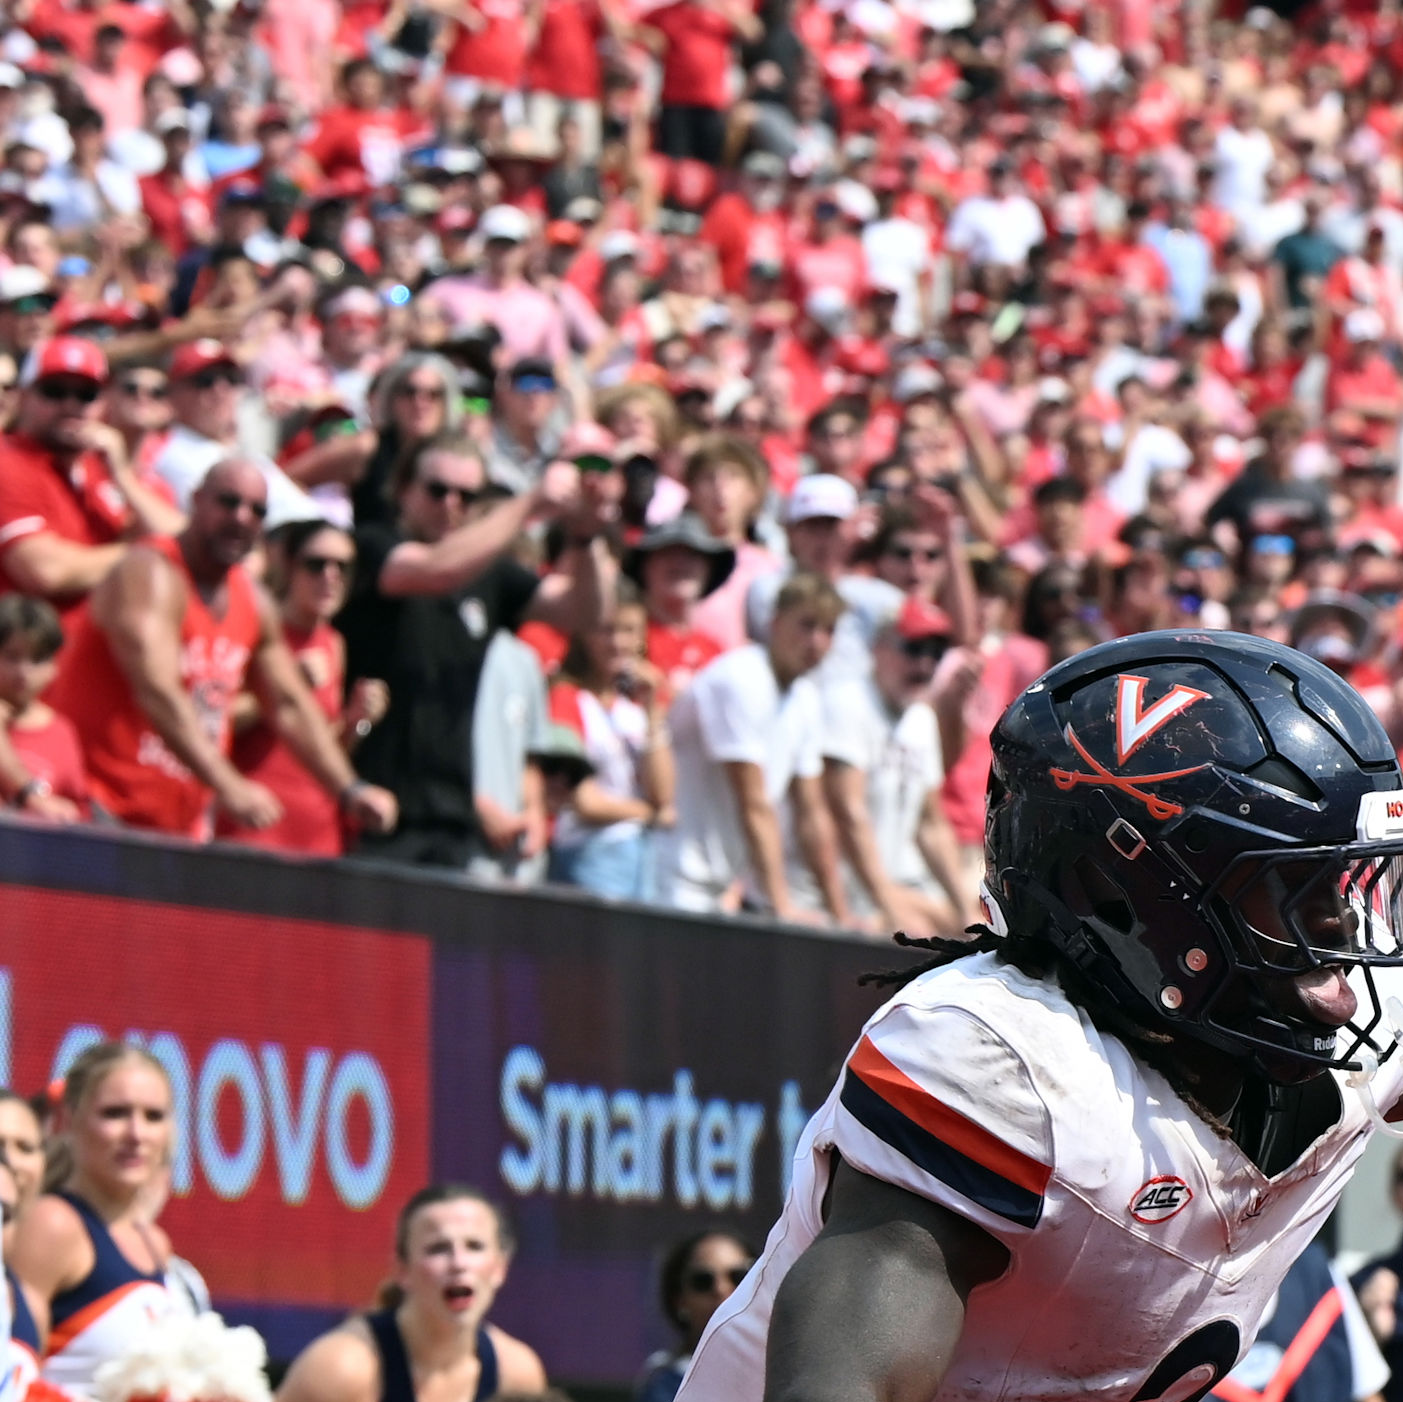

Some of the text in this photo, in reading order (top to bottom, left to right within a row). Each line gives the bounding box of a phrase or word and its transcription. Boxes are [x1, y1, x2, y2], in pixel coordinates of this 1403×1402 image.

[1115, 673, 1213, 767] V
[499, 1043, 766, 1213] Smarter
[1135, 1185, 1187, 1209] ACC
